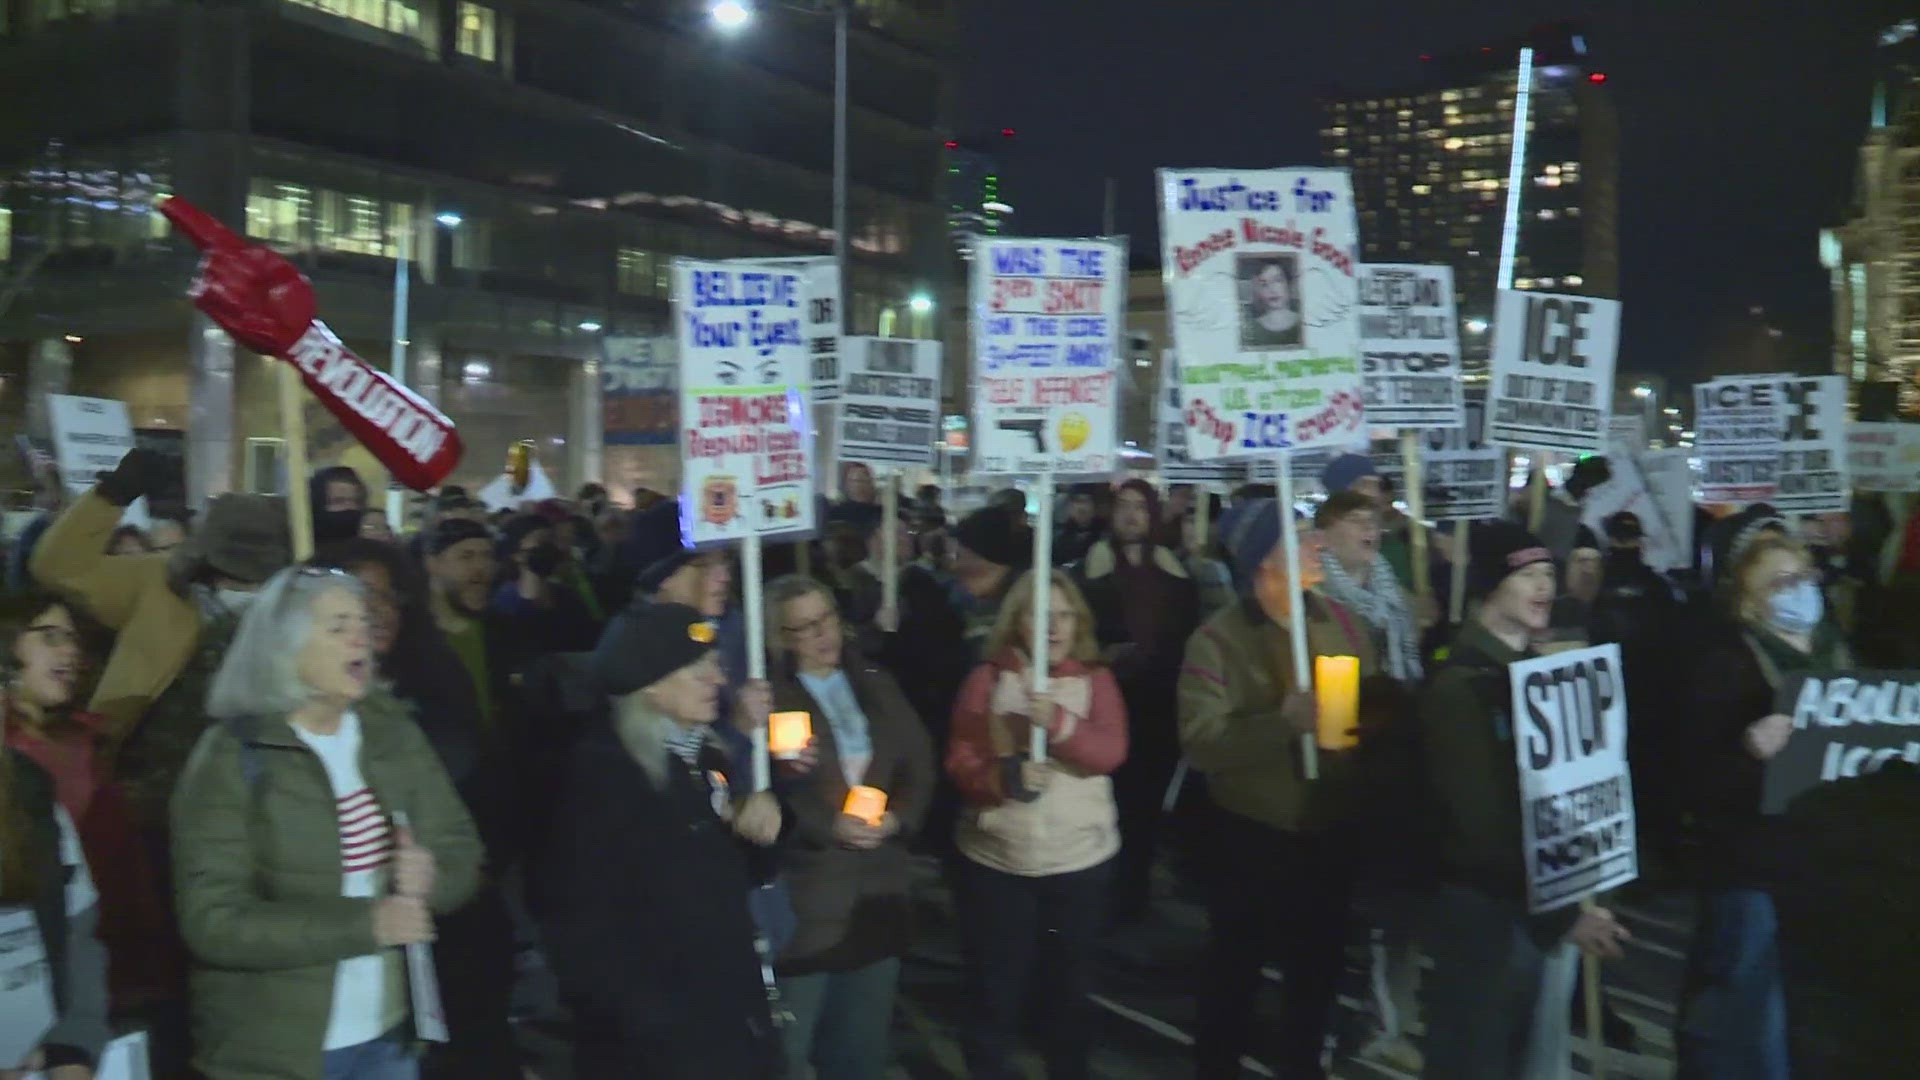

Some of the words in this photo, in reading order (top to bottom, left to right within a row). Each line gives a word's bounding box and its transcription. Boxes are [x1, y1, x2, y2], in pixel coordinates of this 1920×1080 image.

[1058, 248, 1103, 276] THE
[692, 270, 799, 308] BELIEVE
[1522, 296, 1594, 368] ICE
[1363, 351, 1453, 373] STOP
[287, 328, 449, 464] REVOLUTION
[1703, 385, 1772, 408] ICE
[1243, 412, 1294, 448] ICE
[1525, 657, 1613, 770] STOP
